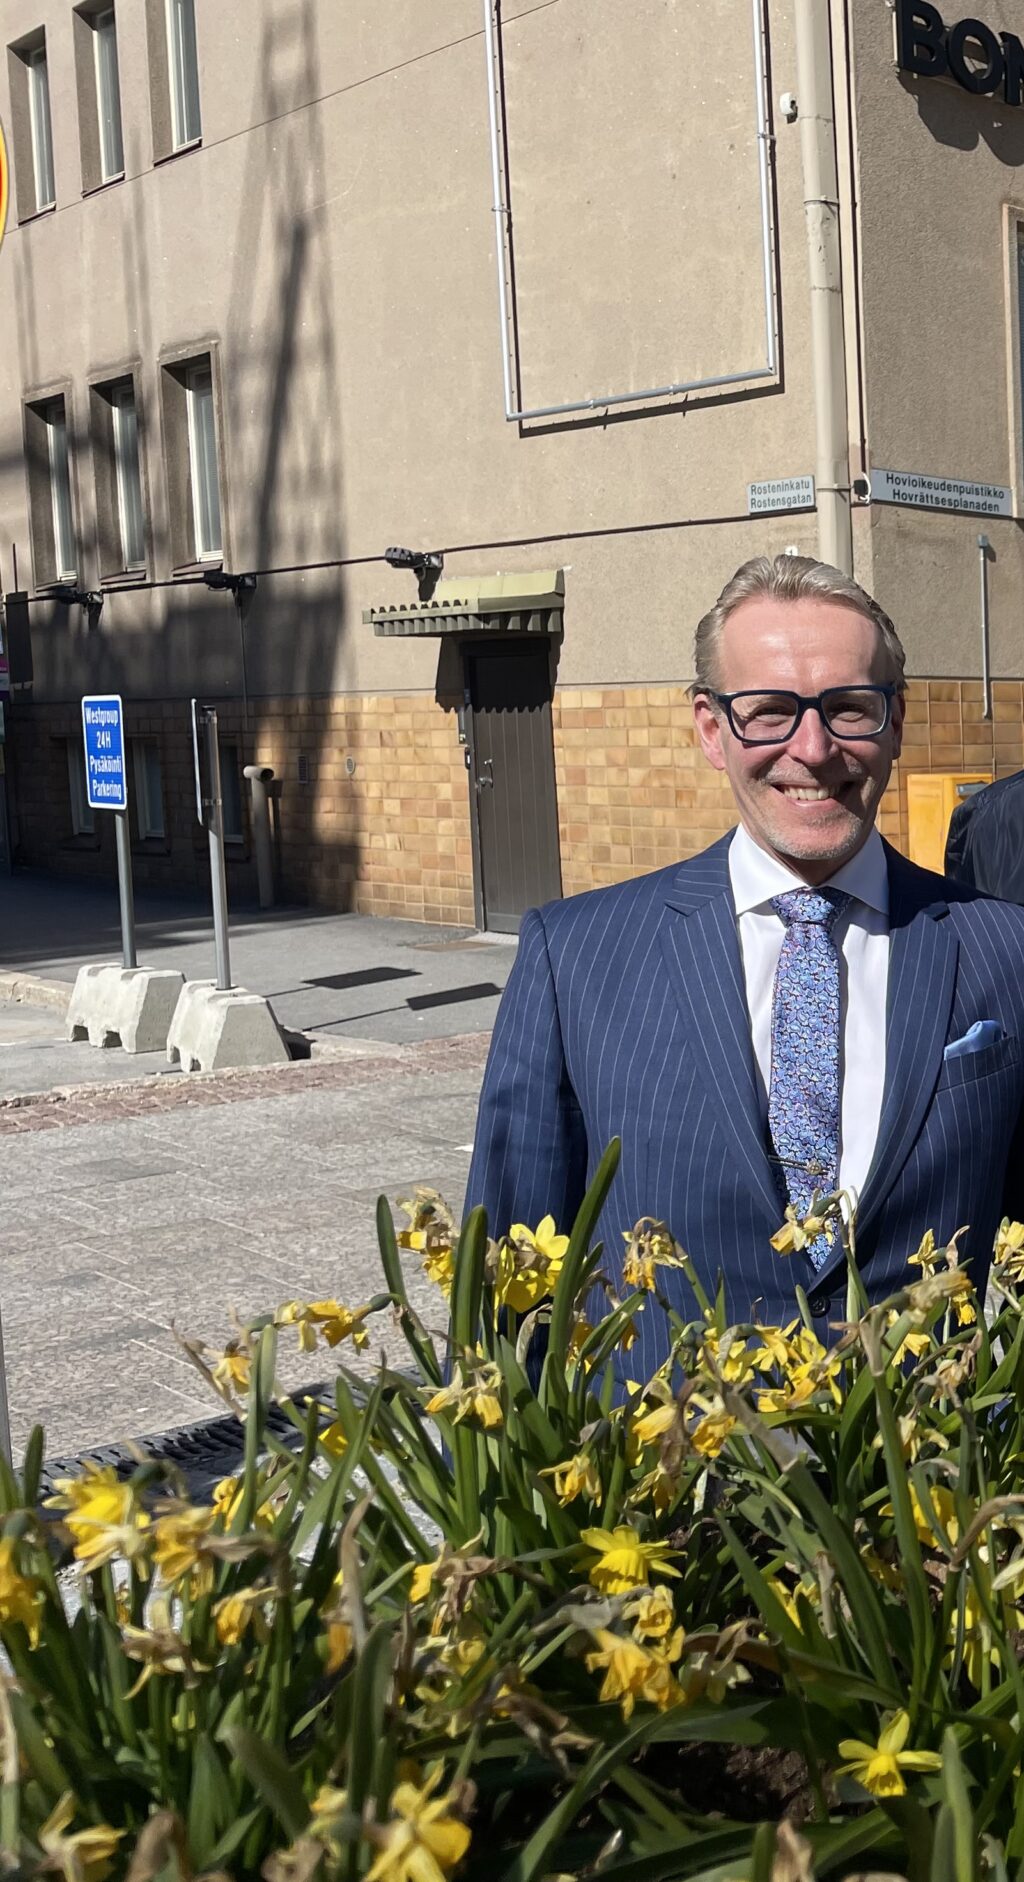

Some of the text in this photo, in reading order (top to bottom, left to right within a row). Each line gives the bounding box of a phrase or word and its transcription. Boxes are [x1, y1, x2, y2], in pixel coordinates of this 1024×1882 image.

[751, 479, 810, 496] Rosteninkatu
[886, 473, 1005, 500] Hovioikeudenpuistikko
[751, 493, 812, 511] Rostensgatan
[892, 488, 999, 513] Hovrättsesplanaden
[85, 707, 119, 726] Westgroup
[96, 730, 112, 749] 24H
[89, 754, 122, 775] Pysäköinti
[92, 779, 122, 801] Parkering
